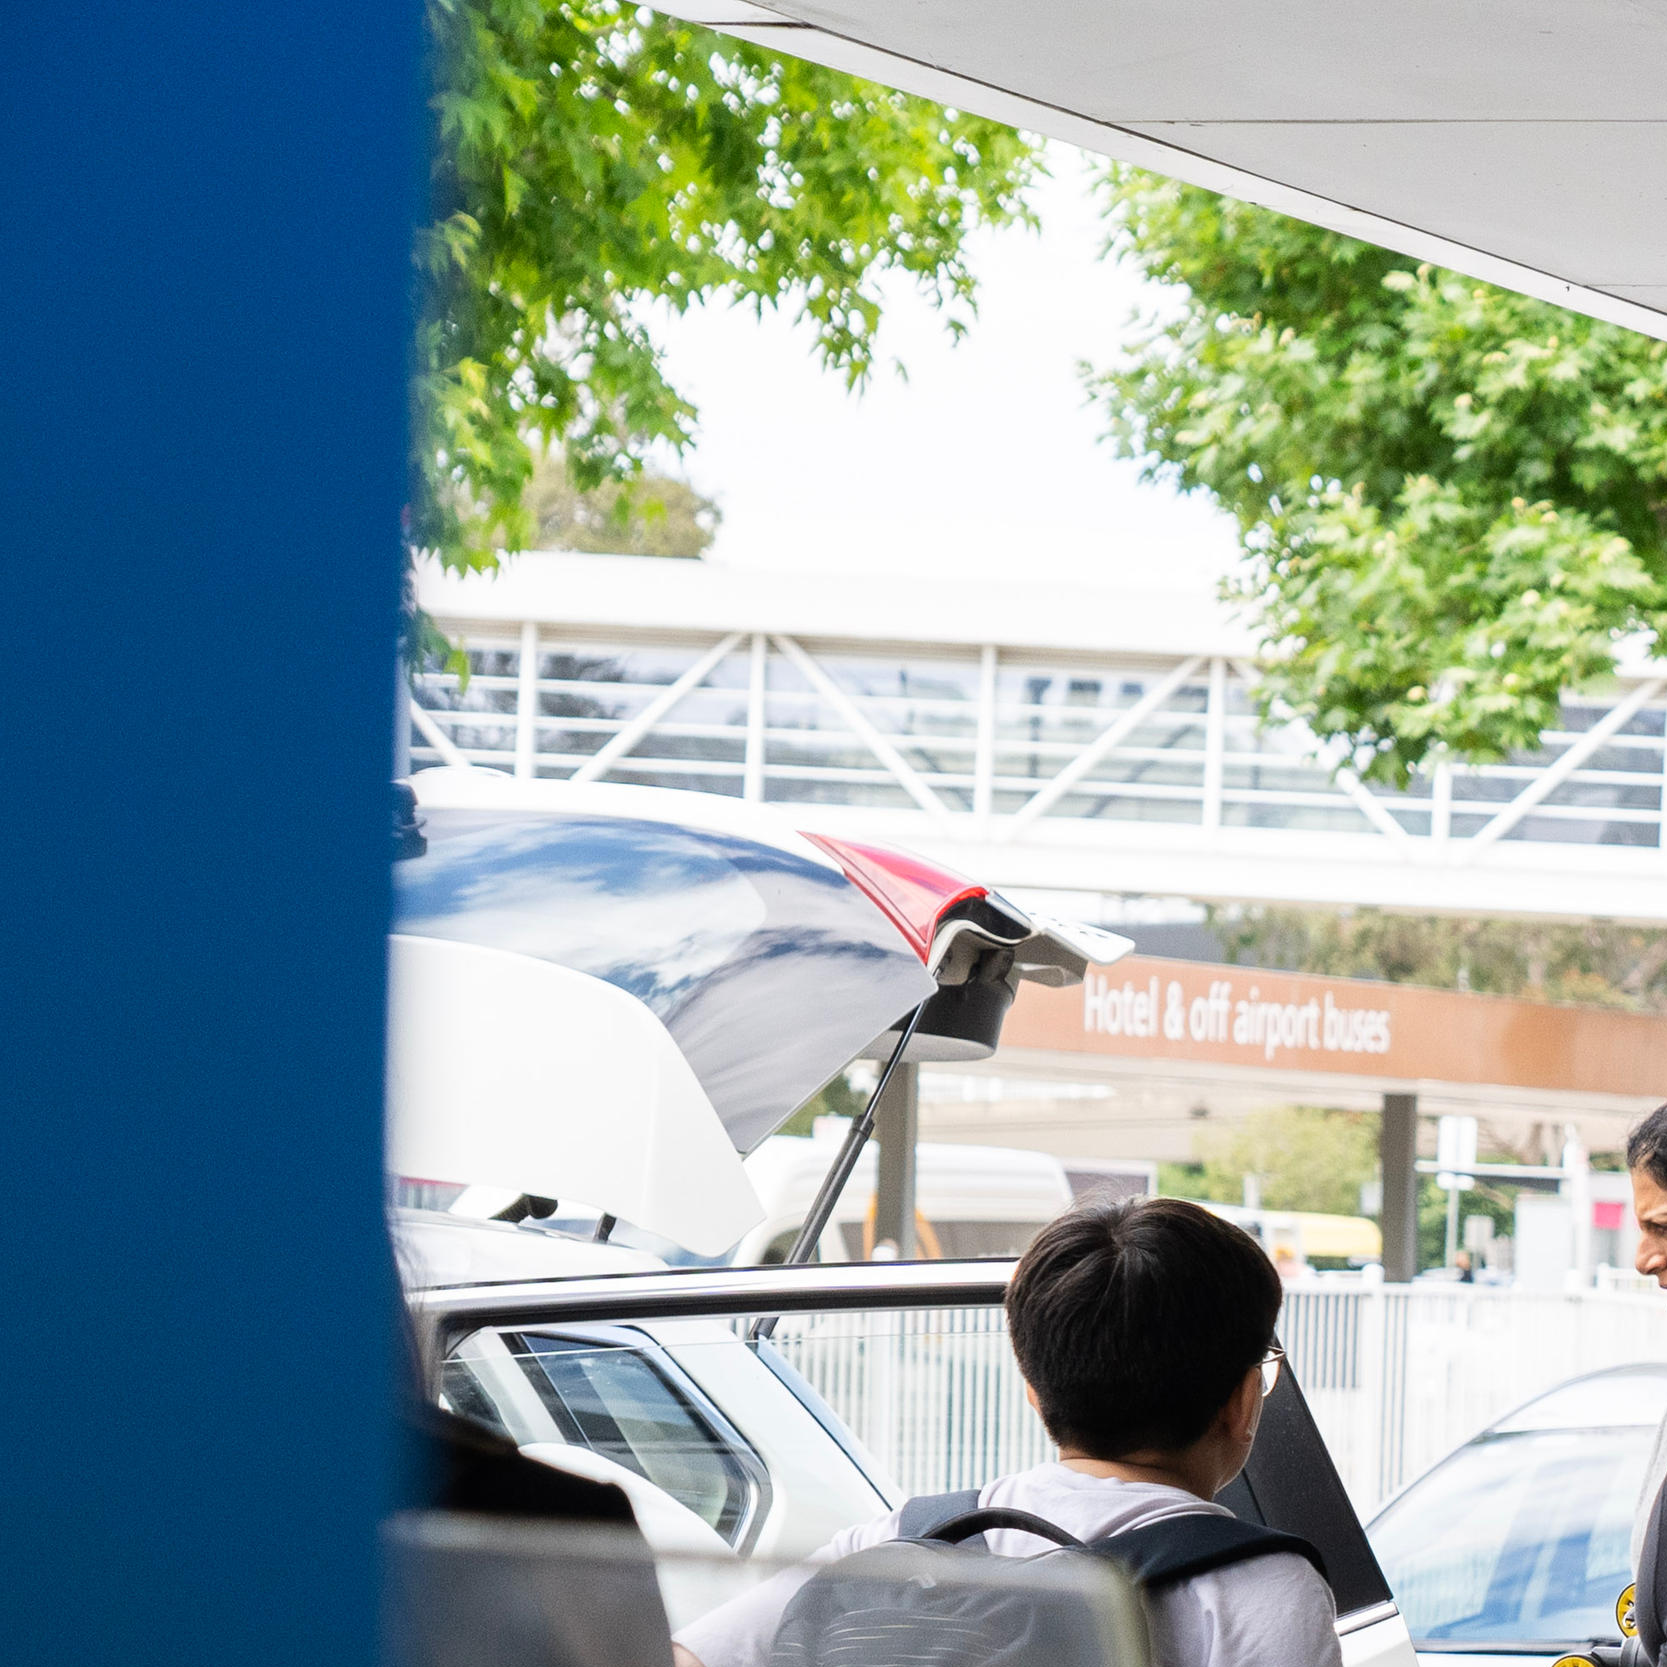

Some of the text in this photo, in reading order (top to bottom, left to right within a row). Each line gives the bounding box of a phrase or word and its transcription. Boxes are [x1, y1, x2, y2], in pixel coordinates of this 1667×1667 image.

[1084, 974, 1392, 1061] Hotel & off airport buses
